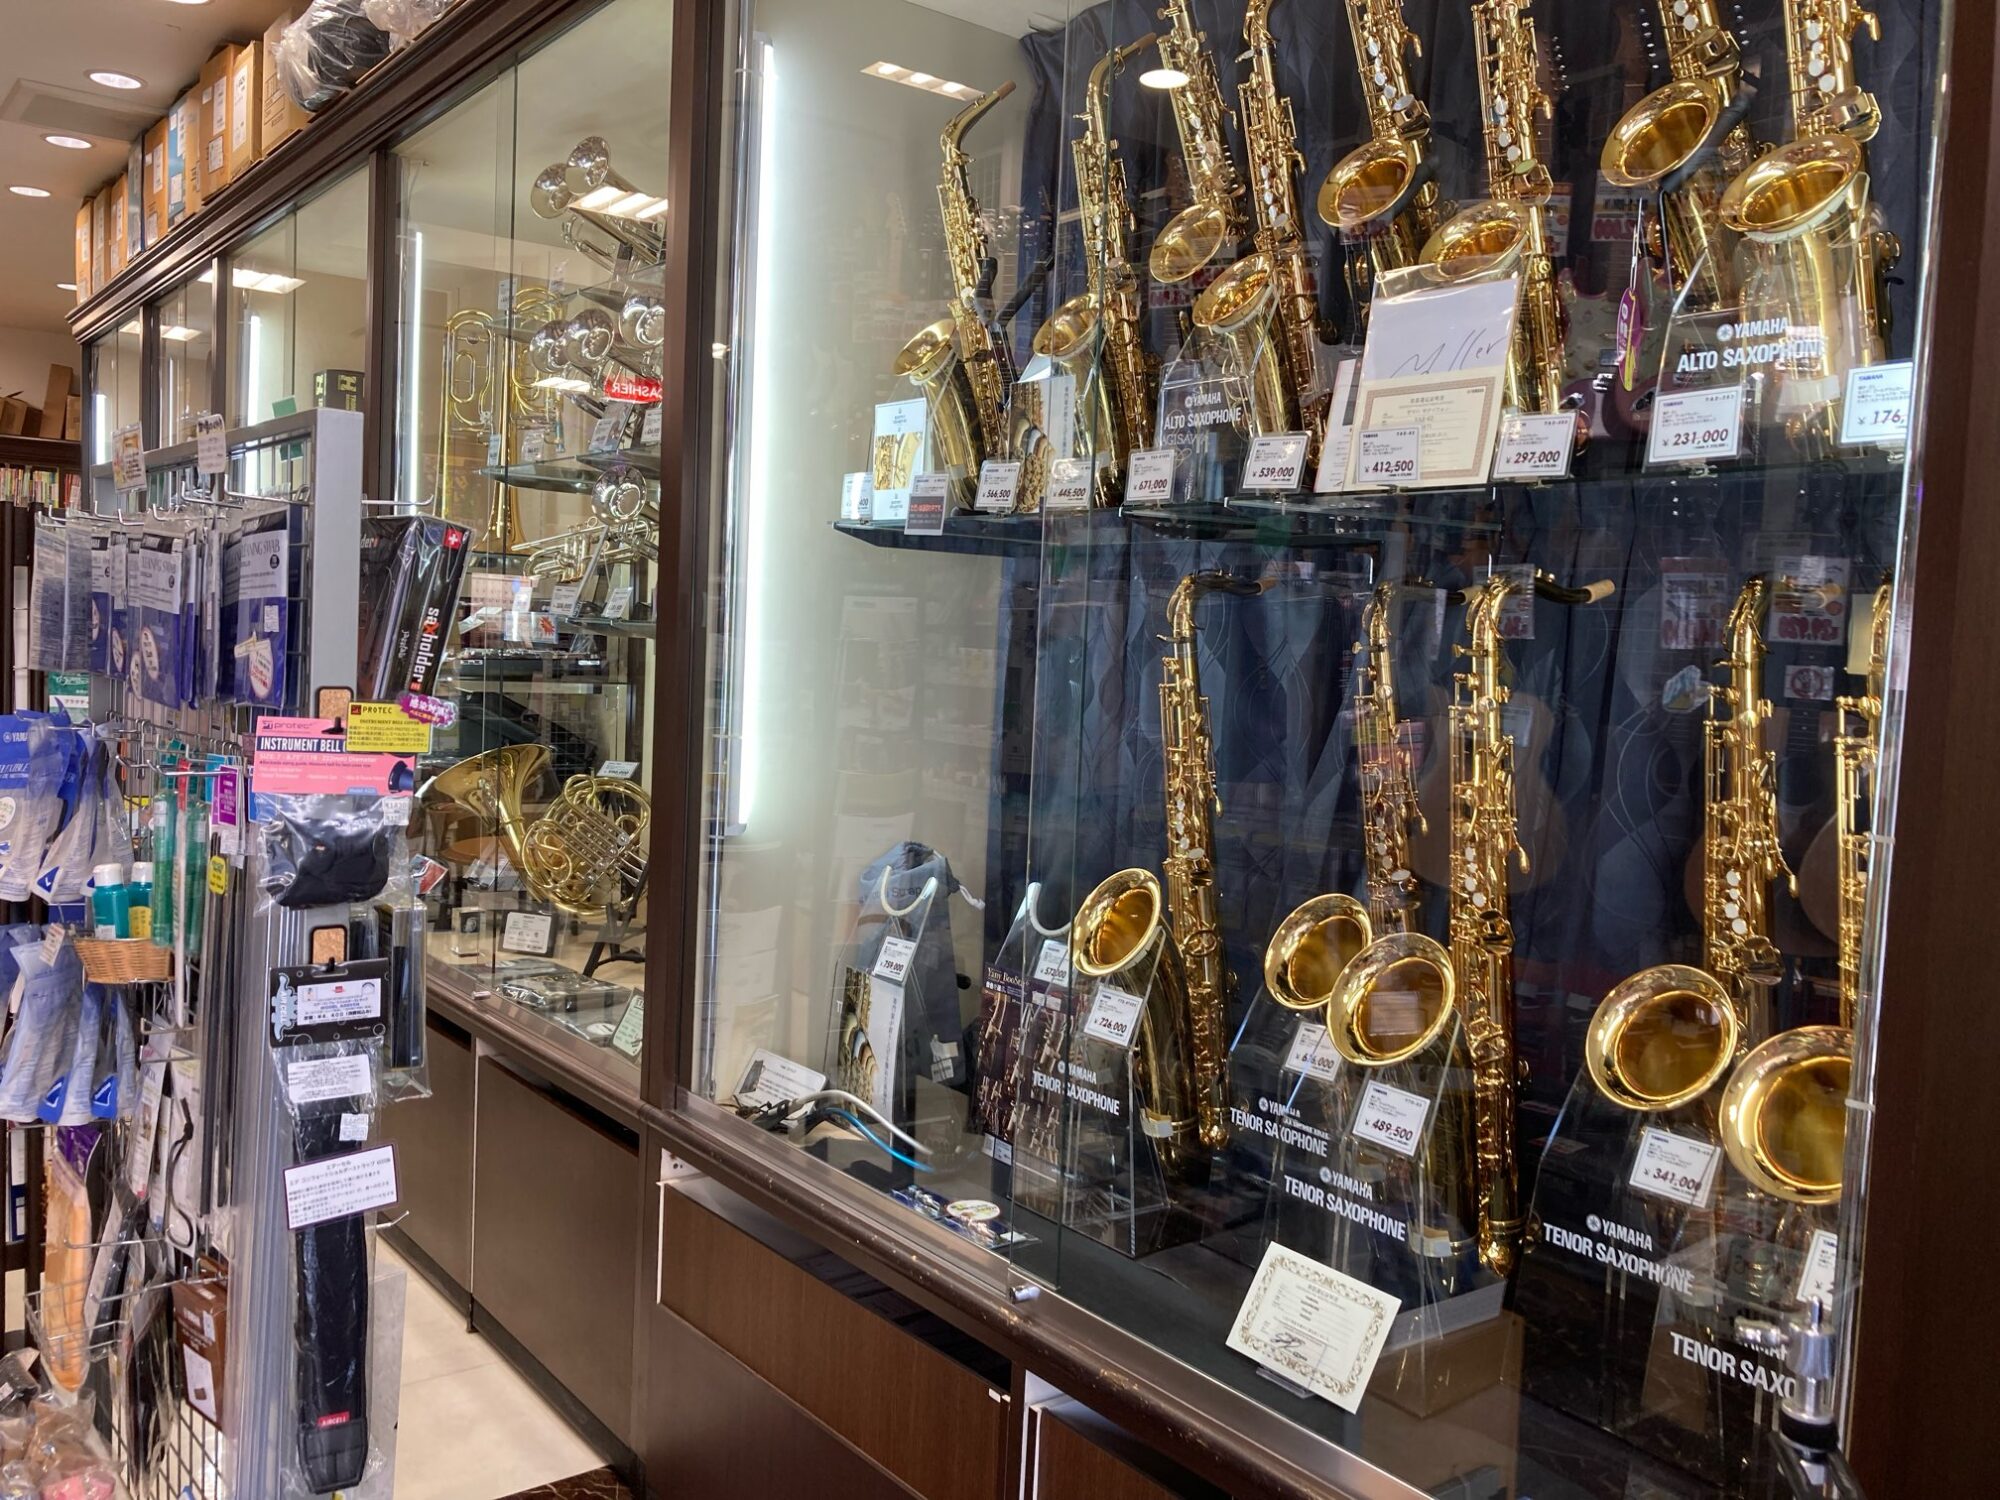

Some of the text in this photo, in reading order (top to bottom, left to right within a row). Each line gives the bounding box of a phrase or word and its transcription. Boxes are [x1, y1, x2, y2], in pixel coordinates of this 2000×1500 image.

[1733, 317, 1789, 338] YAMAHA
[1677, 339, 1827, 373] ALTO SAXOPHONE
[1190, 391, 1221, 406] YAMAHA
[1164, 407, 1242, 431] ALTO SAXOPHONE
[1872, 409, 1906, 425] 176,
[1673, 429, 1729, 446] 231,000
[1372, 459, 1414, 473] 412,500
[1513, 450, 1561, 464] 297,000
[1258, 466, 1295, 478] 539,000
[1138, 478, 1168, 491] 671,000
[987, 489, 1011, 499] 566,500
[362, 706, 393, 714] PROTEC
[260, 736, 318, 752] INSTRUMENT
[320, 738, 340, 753] BELL
[884, 959, 904, 973] 759,000
[1044, 967, 1067, 979] 572000
[1098, 1017, 1128, 1033] 726,000
[1302, 1052, 1334, 1070] 66,000
[1033, 1069, 1060, 1095] TENOR
[1069, 1063, 1097, 1085] YAMAHA
[1230, 1107, 1263, 1133] TENOR
[1372, 1118, 1414, 1142] 489,500
[1332, 1170, 1373, 1201] YAMAHA
[1652, 1167, 1702, 1192] 341,000
[1284, 1175, 1406, 1242] TENOR SAXOPHONE
[1601, 1219, 1653, 1251] YAMAHA
[1543, 1222, 1694, 1297] TENOR SAXOPHONE
[1670, 1331, 1736, 1378] TENOR
[1739, 1359, 1796, 1400] SAXO
